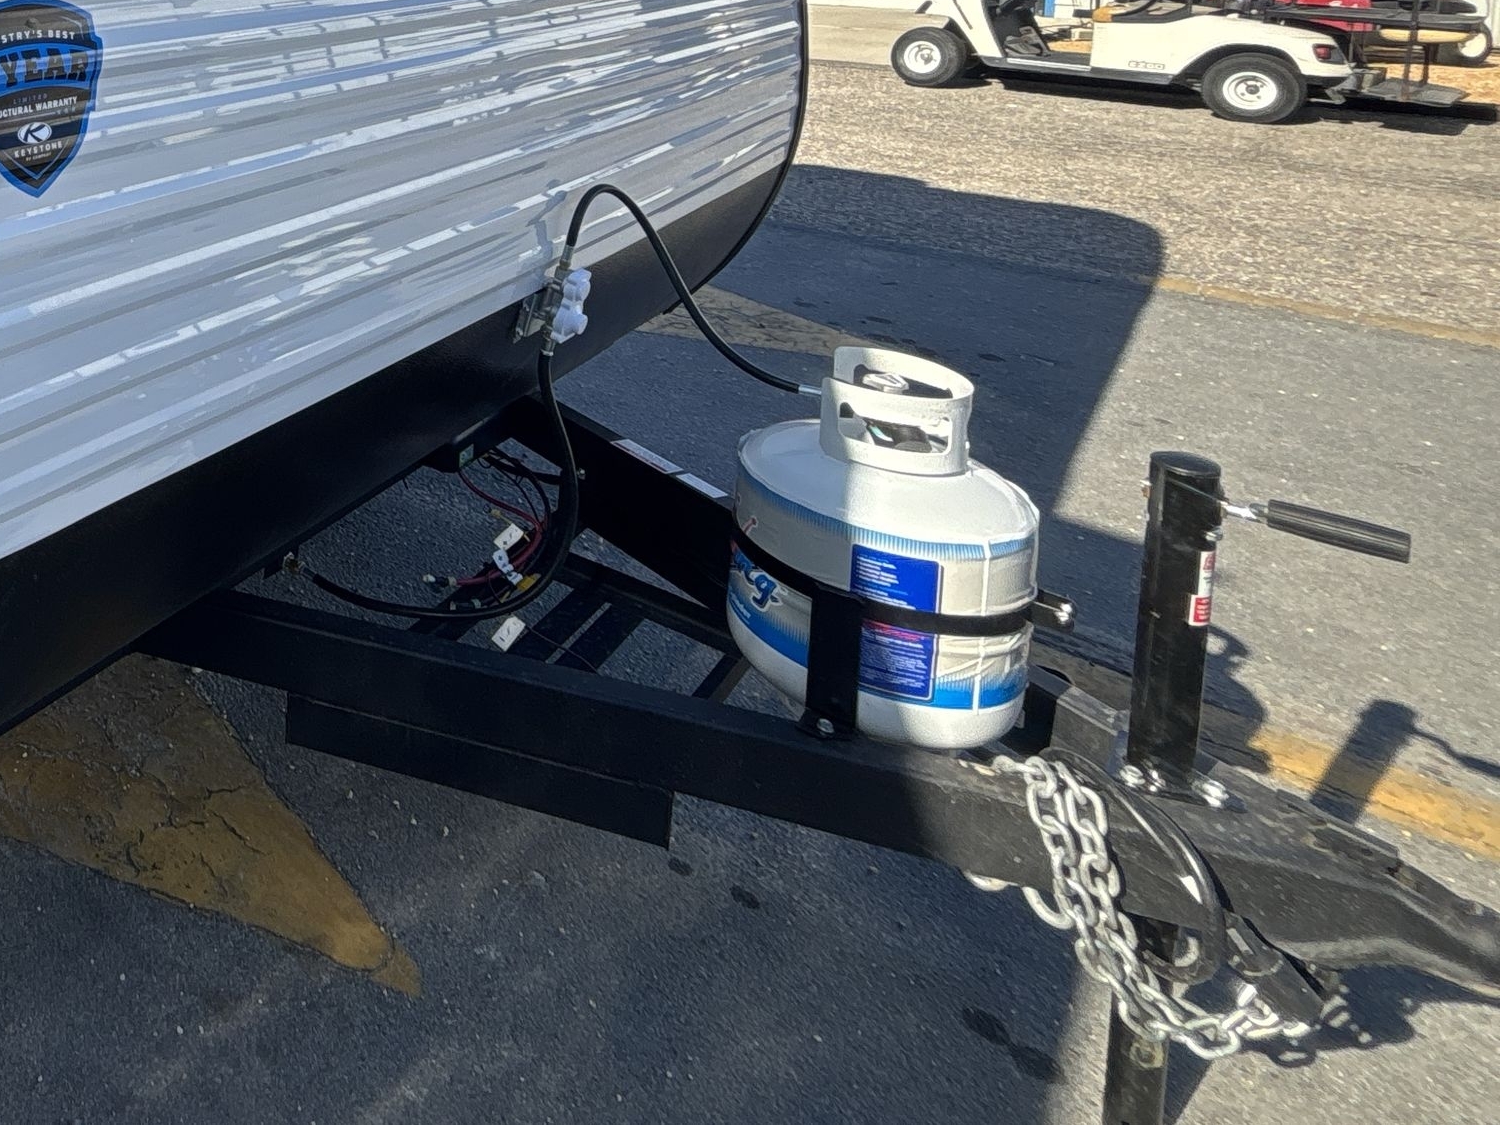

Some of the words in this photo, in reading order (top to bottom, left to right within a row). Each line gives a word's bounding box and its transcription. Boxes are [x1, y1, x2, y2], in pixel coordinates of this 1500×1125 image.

[47, 29, 76, 40] BEST
[35, 96, 78, 111] WARRANTY
[14, 141, 63, 158] KEYSTONE
